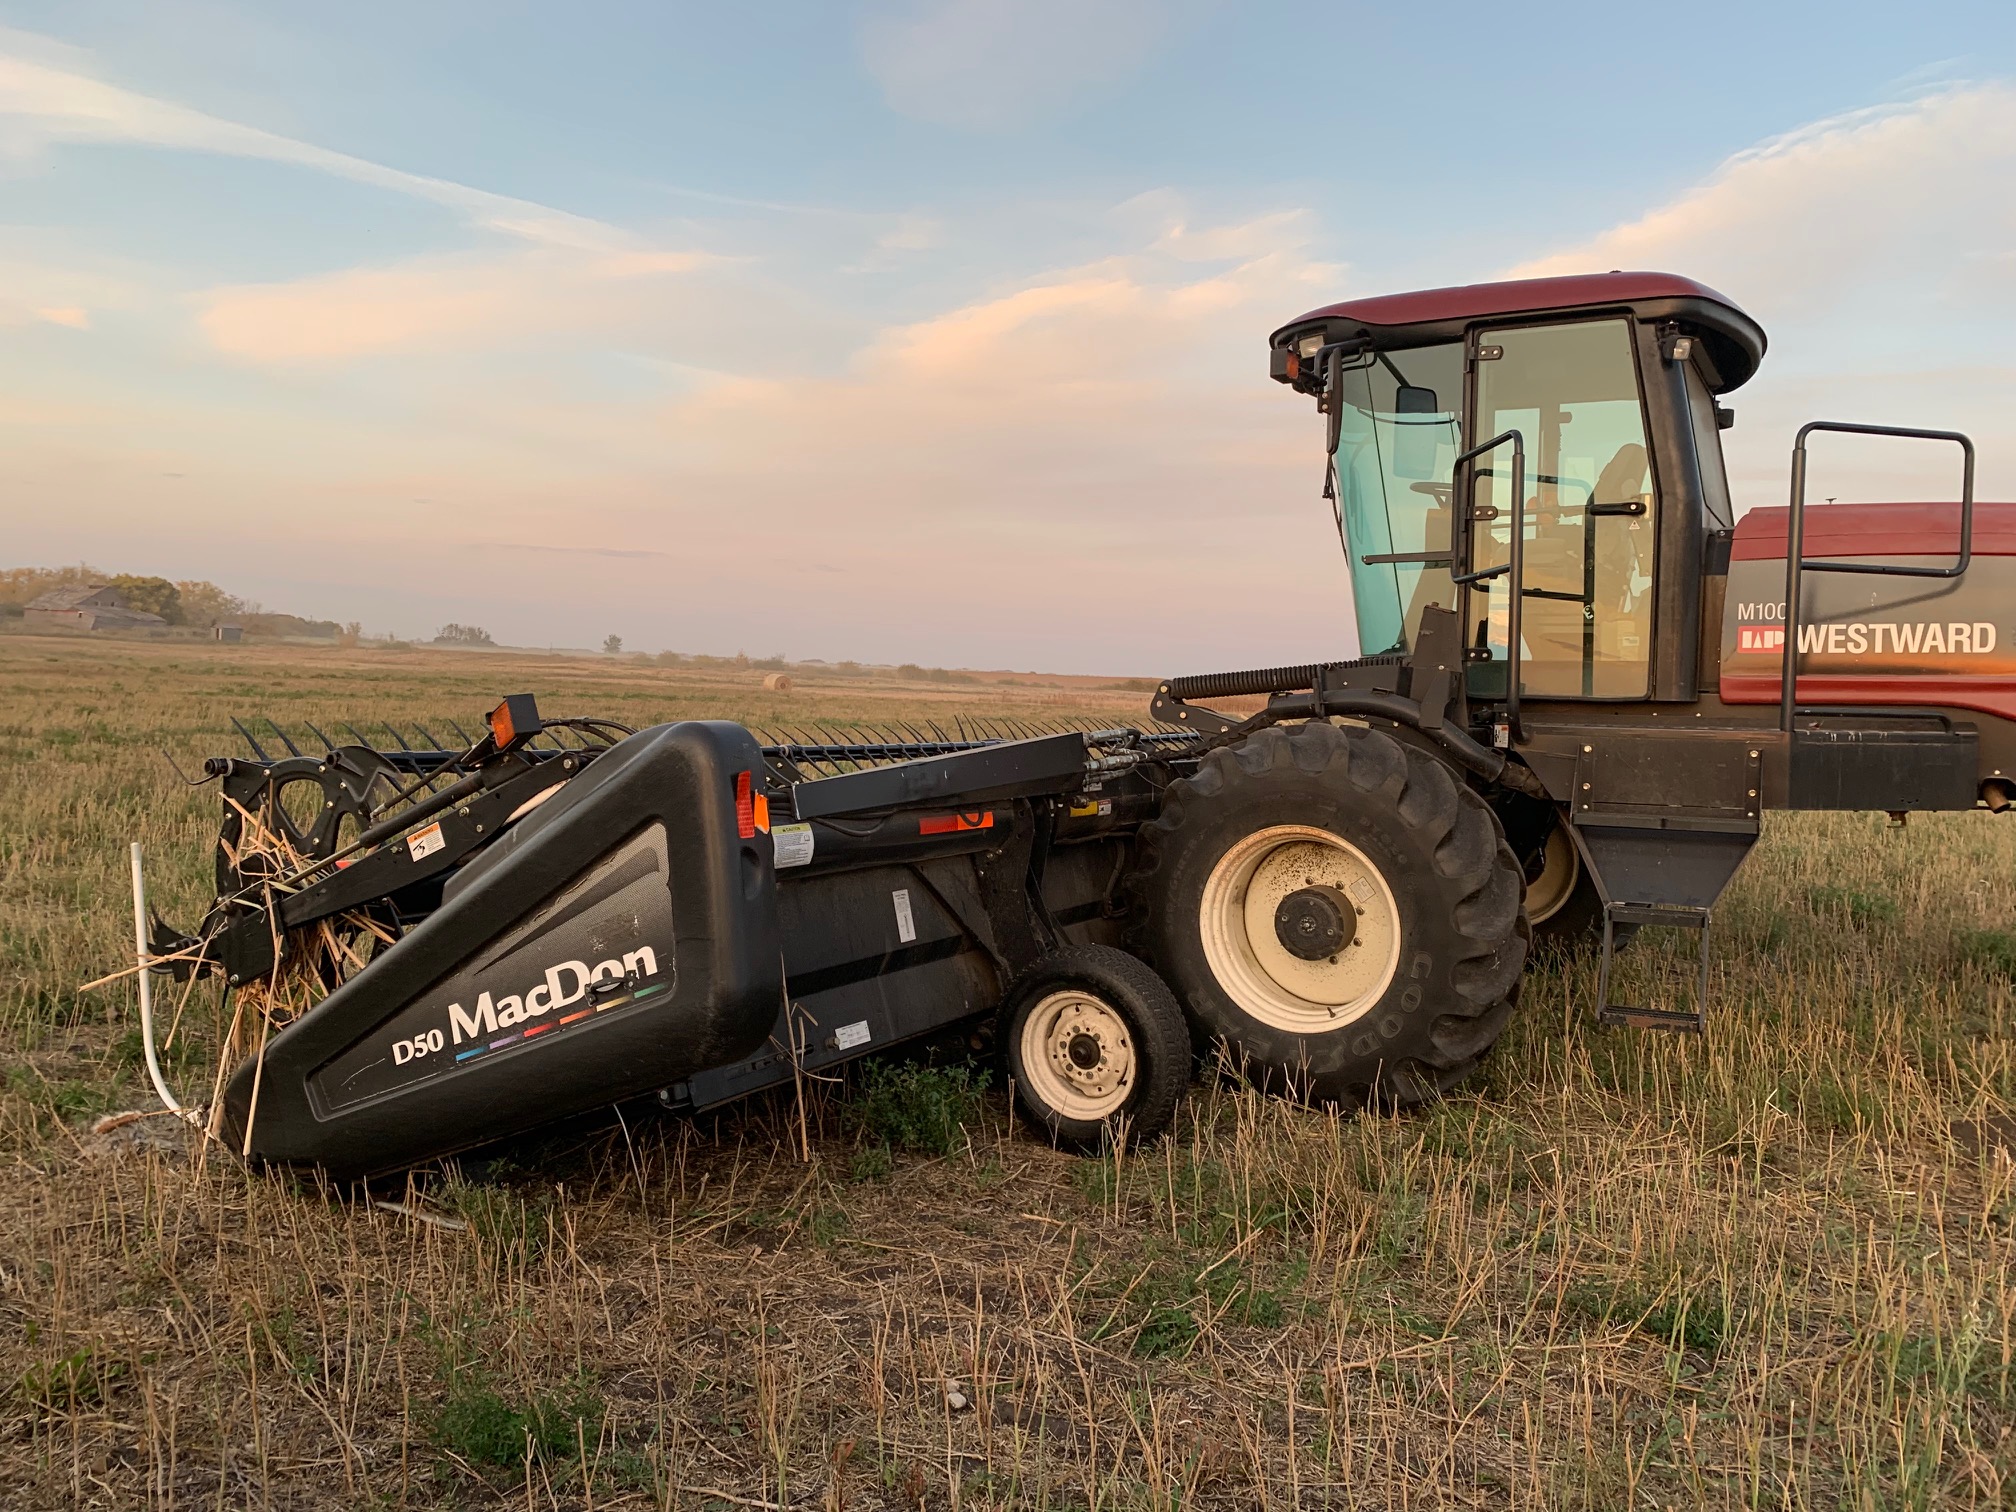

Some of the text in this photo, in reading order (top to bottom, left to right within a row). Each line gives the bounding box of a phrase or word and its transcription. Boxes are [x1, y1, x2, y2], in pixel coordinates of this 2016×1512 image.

[1737, 602, 1786, 621] M100
[1797, 622, 1997, 655] WESTWARD
[391, 945, 658, 1066] D50 MacDon
